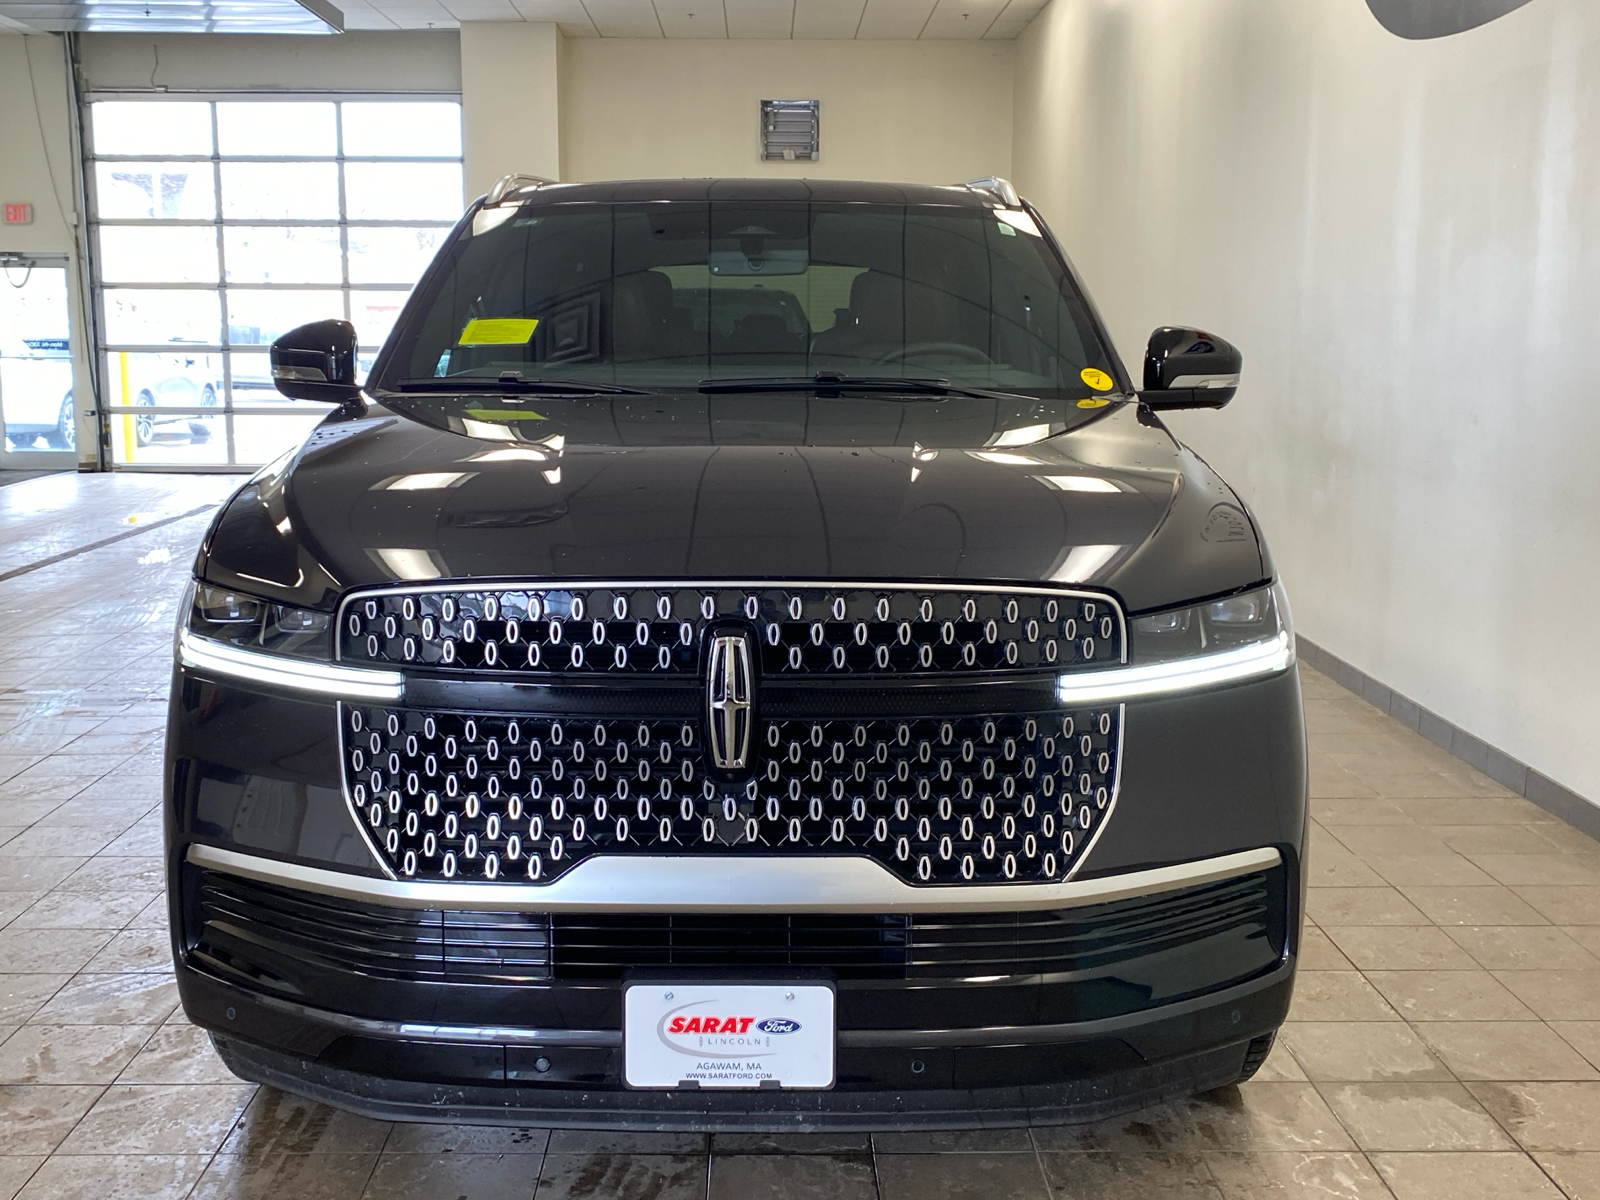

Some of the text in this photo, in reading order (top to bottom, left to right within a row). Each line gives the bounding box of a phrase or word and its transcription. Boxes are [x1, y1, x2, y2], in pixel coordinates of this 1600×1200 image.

[5, 203, 27, 221] EXIT
[667, 1015, 794, 1035] SARAT Ford
[707, 1037, 761, 1046] LINCOLN
[696, 1062, 762, 1071] AGAWAM, MA
[685, 1072, 773, 1080] WWW.SARATFORD.COM
